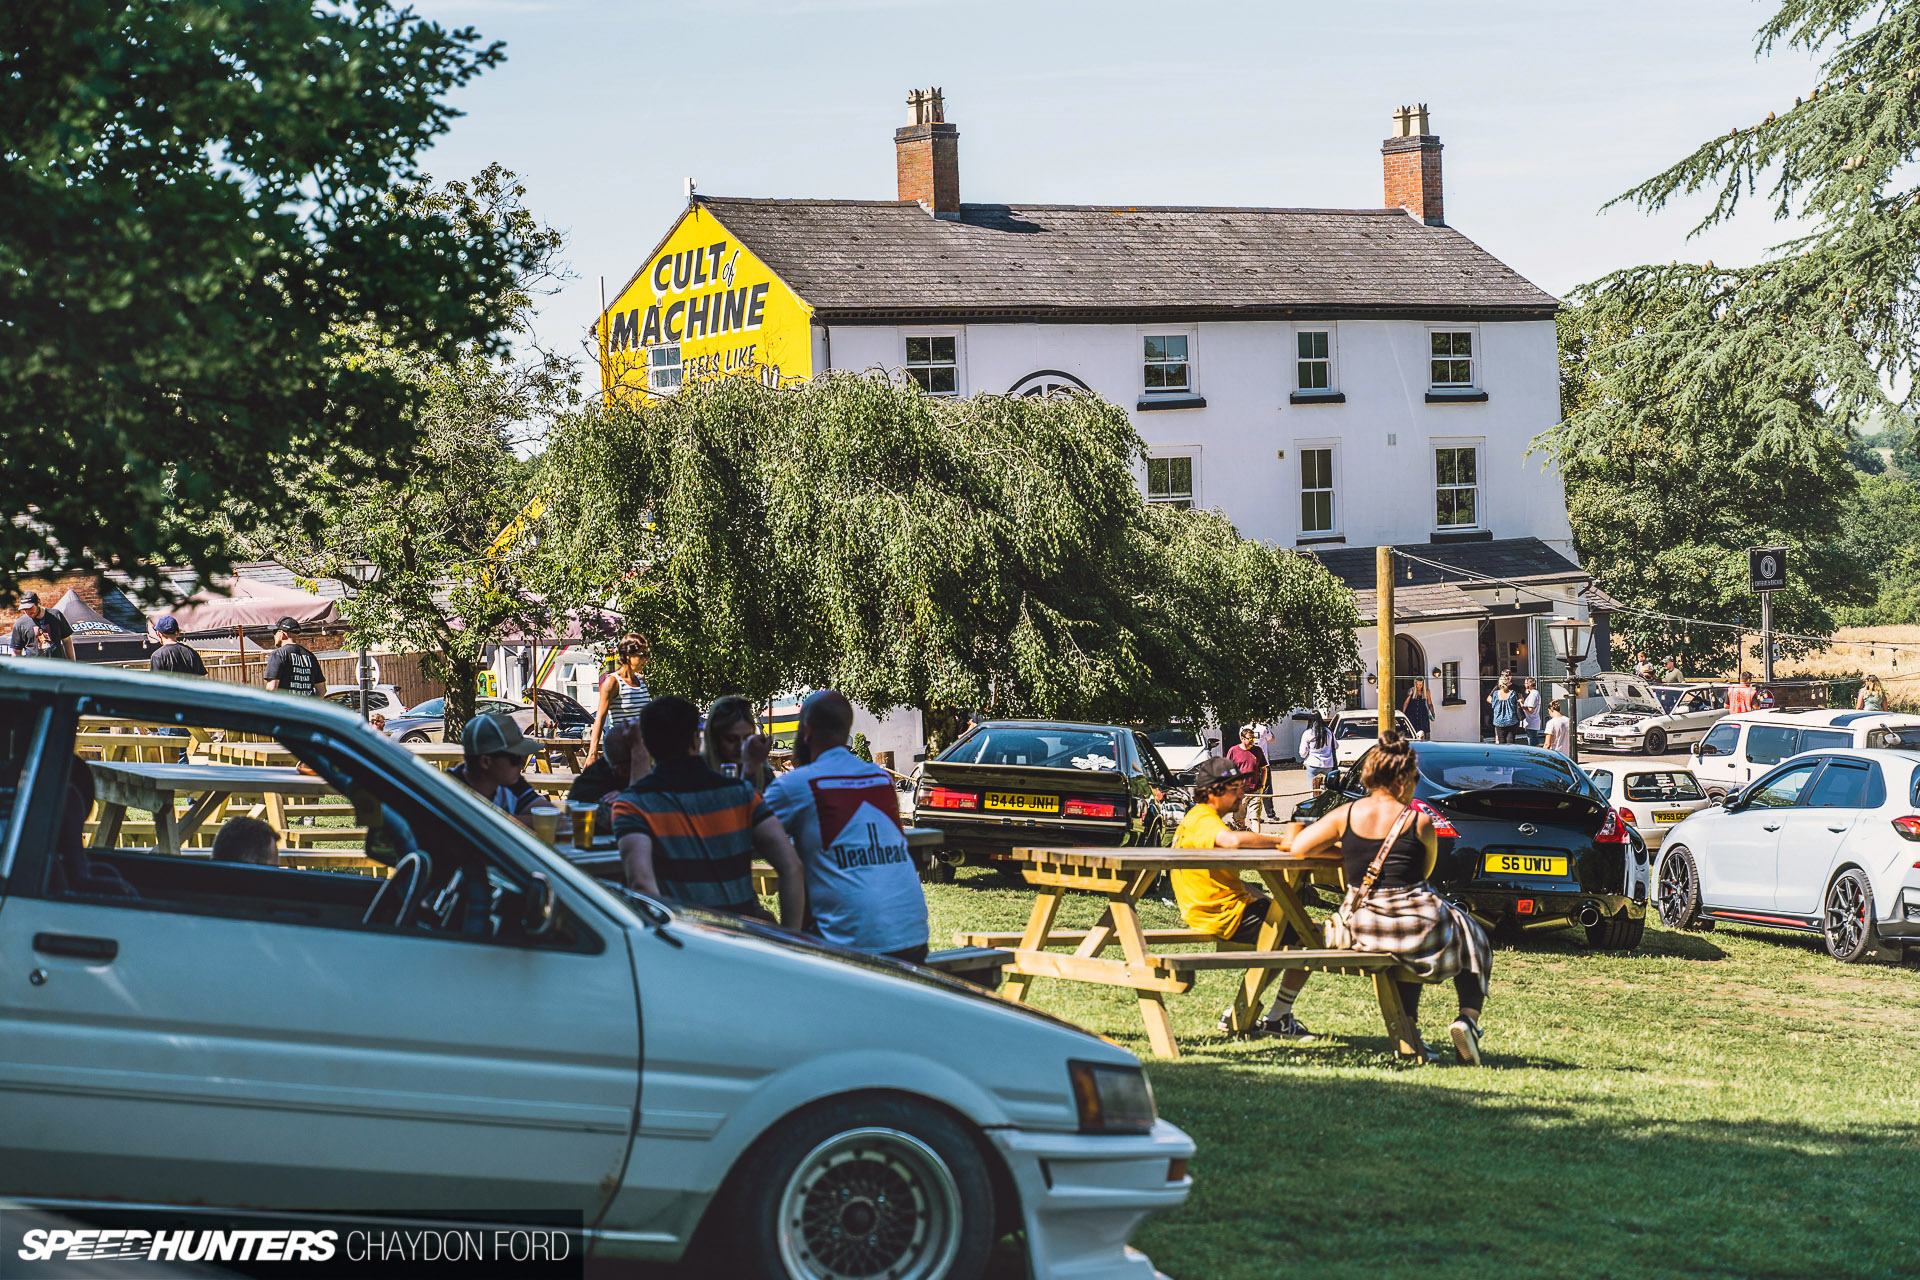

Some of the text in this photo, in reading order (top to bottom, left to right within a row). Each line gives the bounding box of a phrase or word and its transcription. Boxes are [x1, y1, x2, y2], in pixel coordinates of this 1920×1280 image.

[652, 241, 741, 295] CULT of
[609, 281, 770, 355] MACHINE
[681, 343, 757, 381] FEELS LIKE
[991, 794, 1054, 810] B448 JNH
[1658, 813, 1675, 821] R359
[1501, 856, 1552, 872] S6 UWU
